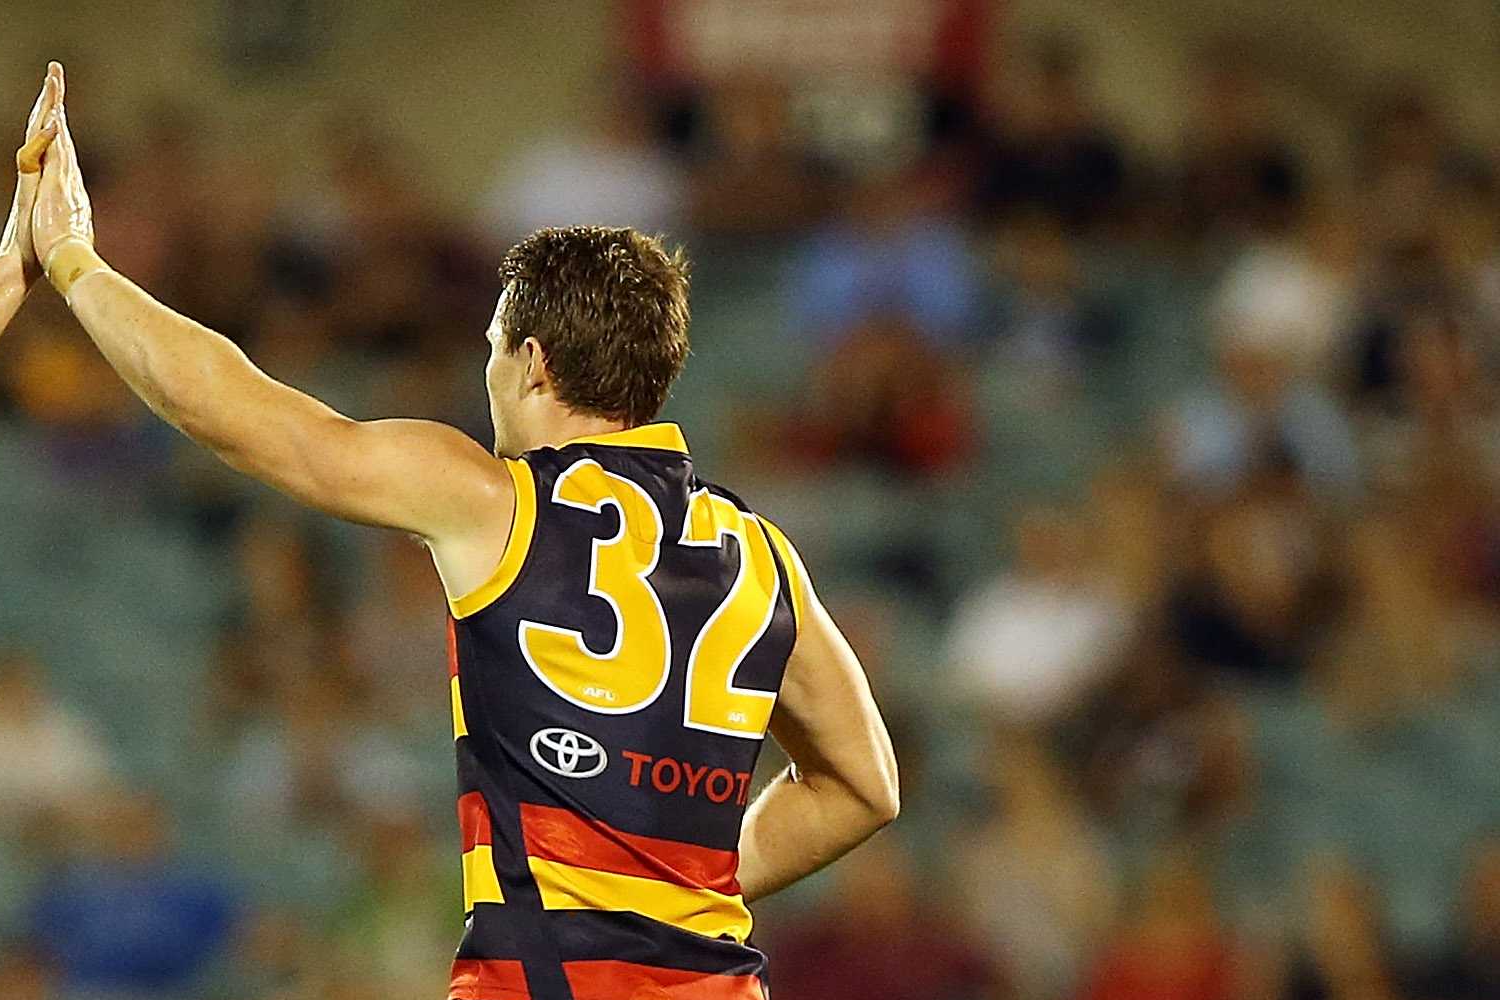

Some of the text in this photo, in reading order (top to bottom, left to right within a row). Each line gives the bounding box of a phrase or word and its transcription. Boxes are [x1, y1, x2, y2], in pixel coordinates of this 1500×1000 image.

[518, 458, 780, 739] 32
[582, 686, 616, 701] AFL
[621, 750, 750, 806] TOYOT
